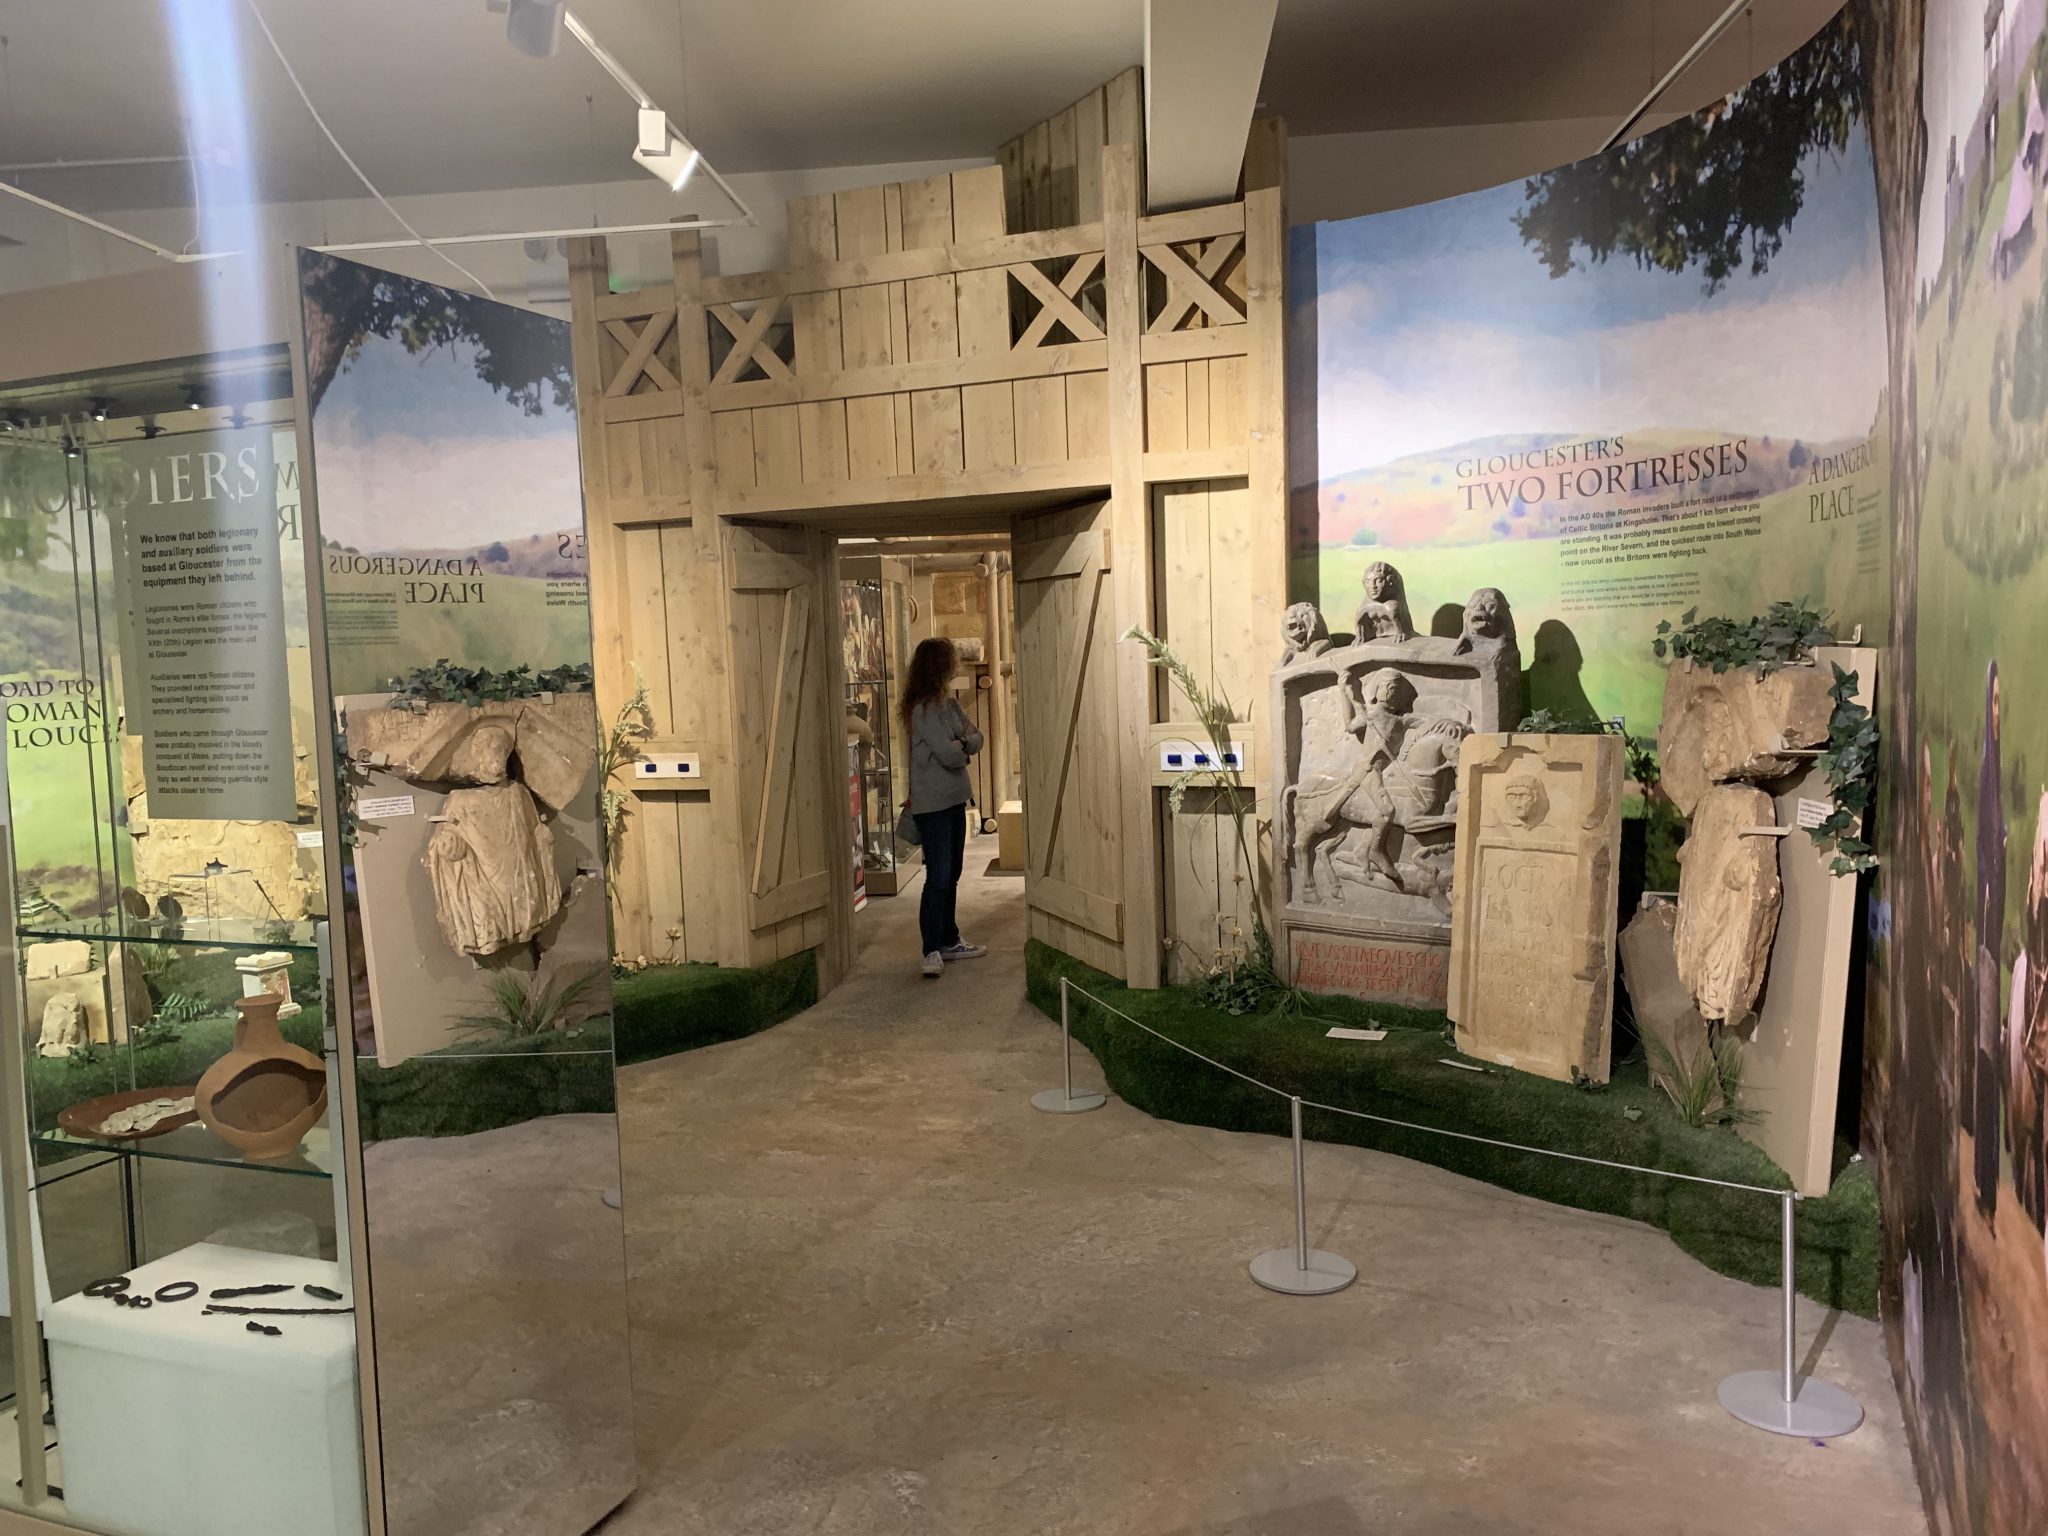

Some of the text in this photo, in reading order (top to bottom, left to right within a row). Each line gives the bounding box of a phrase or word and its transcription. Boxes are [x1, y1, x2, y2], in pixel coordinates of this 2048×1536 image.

[1456, 436, 1624, 479] GLOUCESTER'S
[1458, 438, 1748, 511] TWO FORTRESSES
[1809, 459, 1819, 485] A
[1618, 508, 1640, 516] Roman
[1643, 503, 1669, 512] invaders
[1809, 485, 1854, 523] PLACE
[141, 535, 152, 543] We
[156, 534, 176, 542] know
[180, 532, 194, 540] that
[198, 530, 216, 539] both
[1624, 530, 1650, 538] probably
[142, 550, 156, 558] and
[159, 547, 193, 557] auxiliary
[196, 545, 228, 554] soldiers
[1561, 549, 1578, 558] point
[142, 563, 166, 572] based
[179, 560, 224, 570] Gloucester
[144, 576, 186, 588] equipment
[189, 575, 205, 585] they
[209, 574, 222, 582] left
[59, 679, 94, 695] TO
